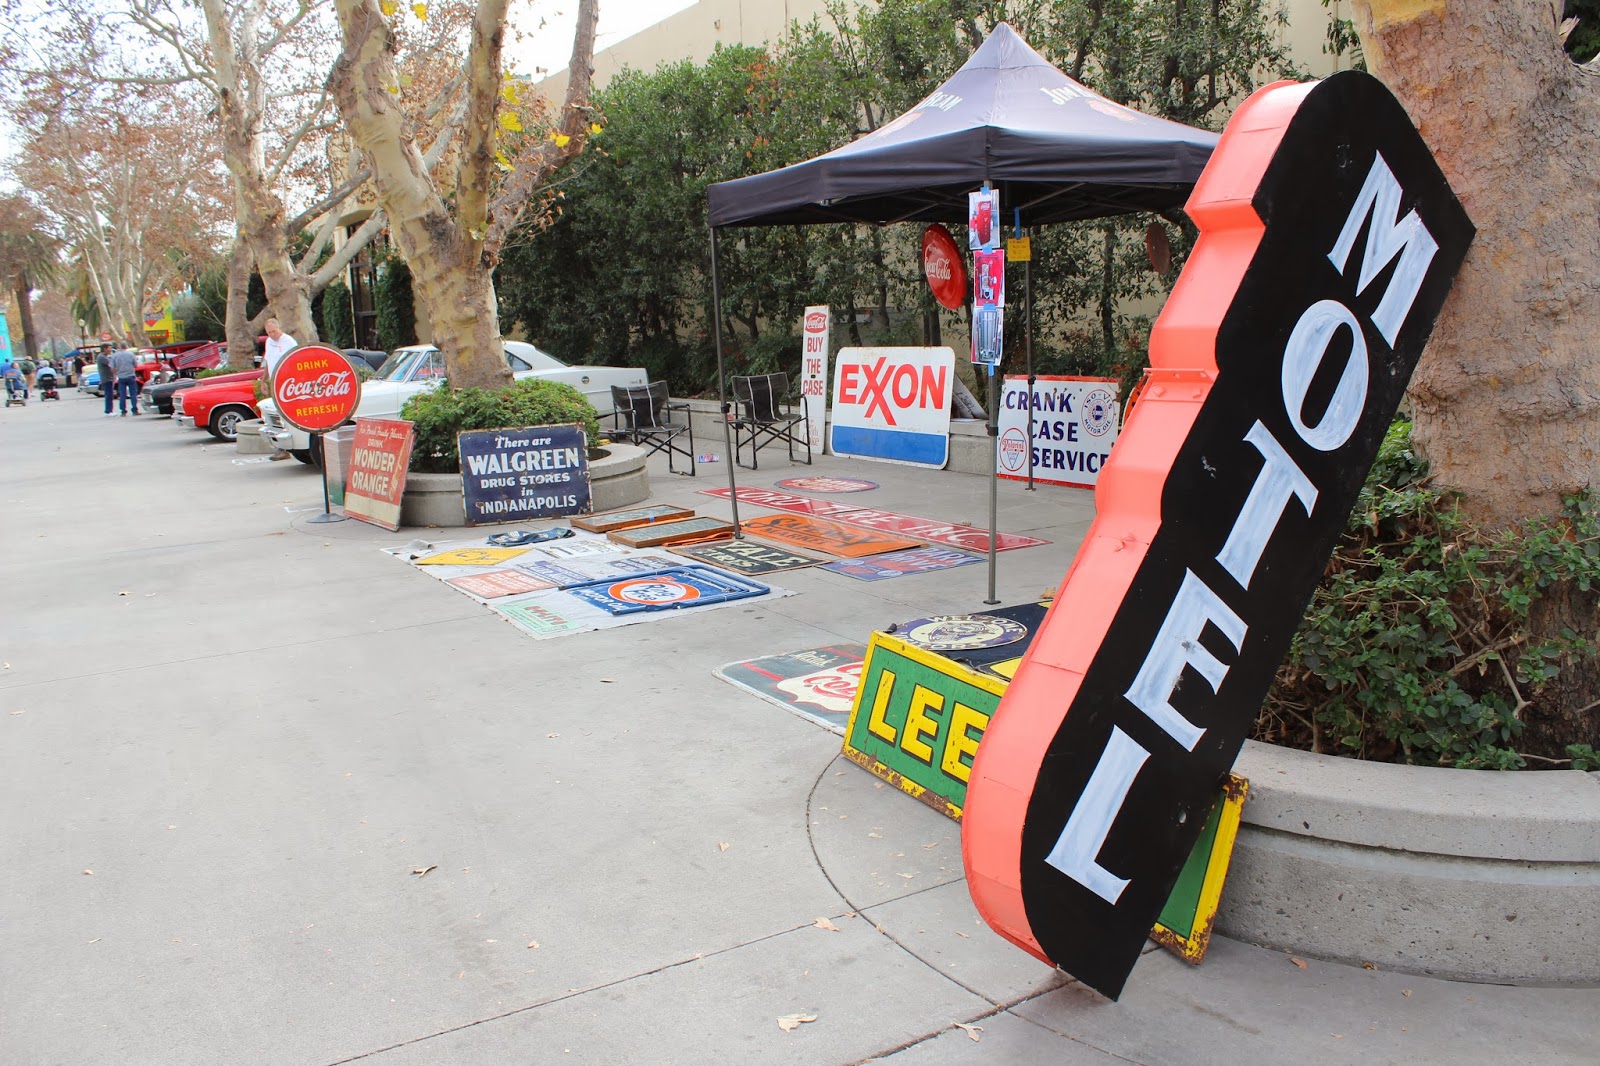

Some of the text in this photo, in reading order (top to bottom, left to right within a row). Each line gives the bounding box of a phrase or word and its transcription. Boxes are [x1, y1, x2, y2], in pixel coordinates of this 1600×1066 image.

[806, 337, 824, 352] BUY
[296, 359, 329, 371] DRINK
[806, 359, 821, 374] THE
[279, 370, 351, 403] Coca-Cola
[803, 380, 824, 396] CASE
[838, 356, 947, 426] EXXON
[1005, 390, 1072, 413] CRANK
[1027, 419, 1079, 443] CASE
[1084, 418, 1111, 434] MOTOR OIL
[367, 438, 383, 448] DRINK
[495, 436, 551, 449] There are
[354, 447, 395, 473] WONDER
[467, 448, 580, 476] WALGREEN
[352, 471, 389, 497] ORANGE
[480, 472, 571, 489] DRUG STORES
[521, 487, 534, 496] in
[480, 495, 577, 514] INDIANAPOLIS
[1045, 149, 1440, 906] MOTEL
[716, 540, 812, 567] YALE
